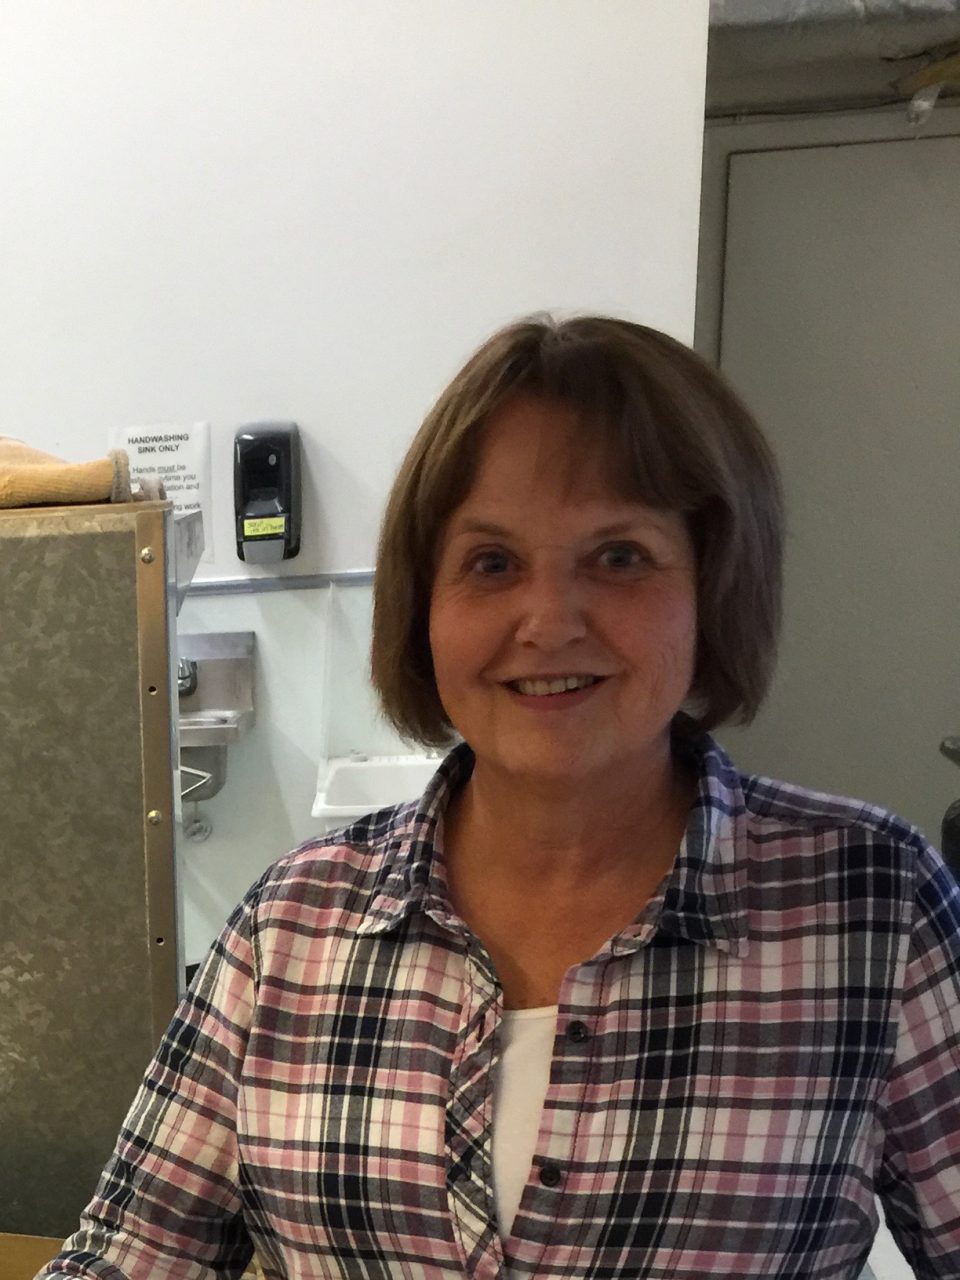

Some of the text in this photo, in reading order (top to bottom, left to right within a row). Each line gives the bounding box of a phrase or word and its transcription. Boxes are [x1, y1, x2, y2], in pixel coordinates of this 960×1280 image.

[128, 433, 189, 444] HANDWASHING
[137, 444, 179, 454] SINK ONLY
[157, 464, 175, 473] must
